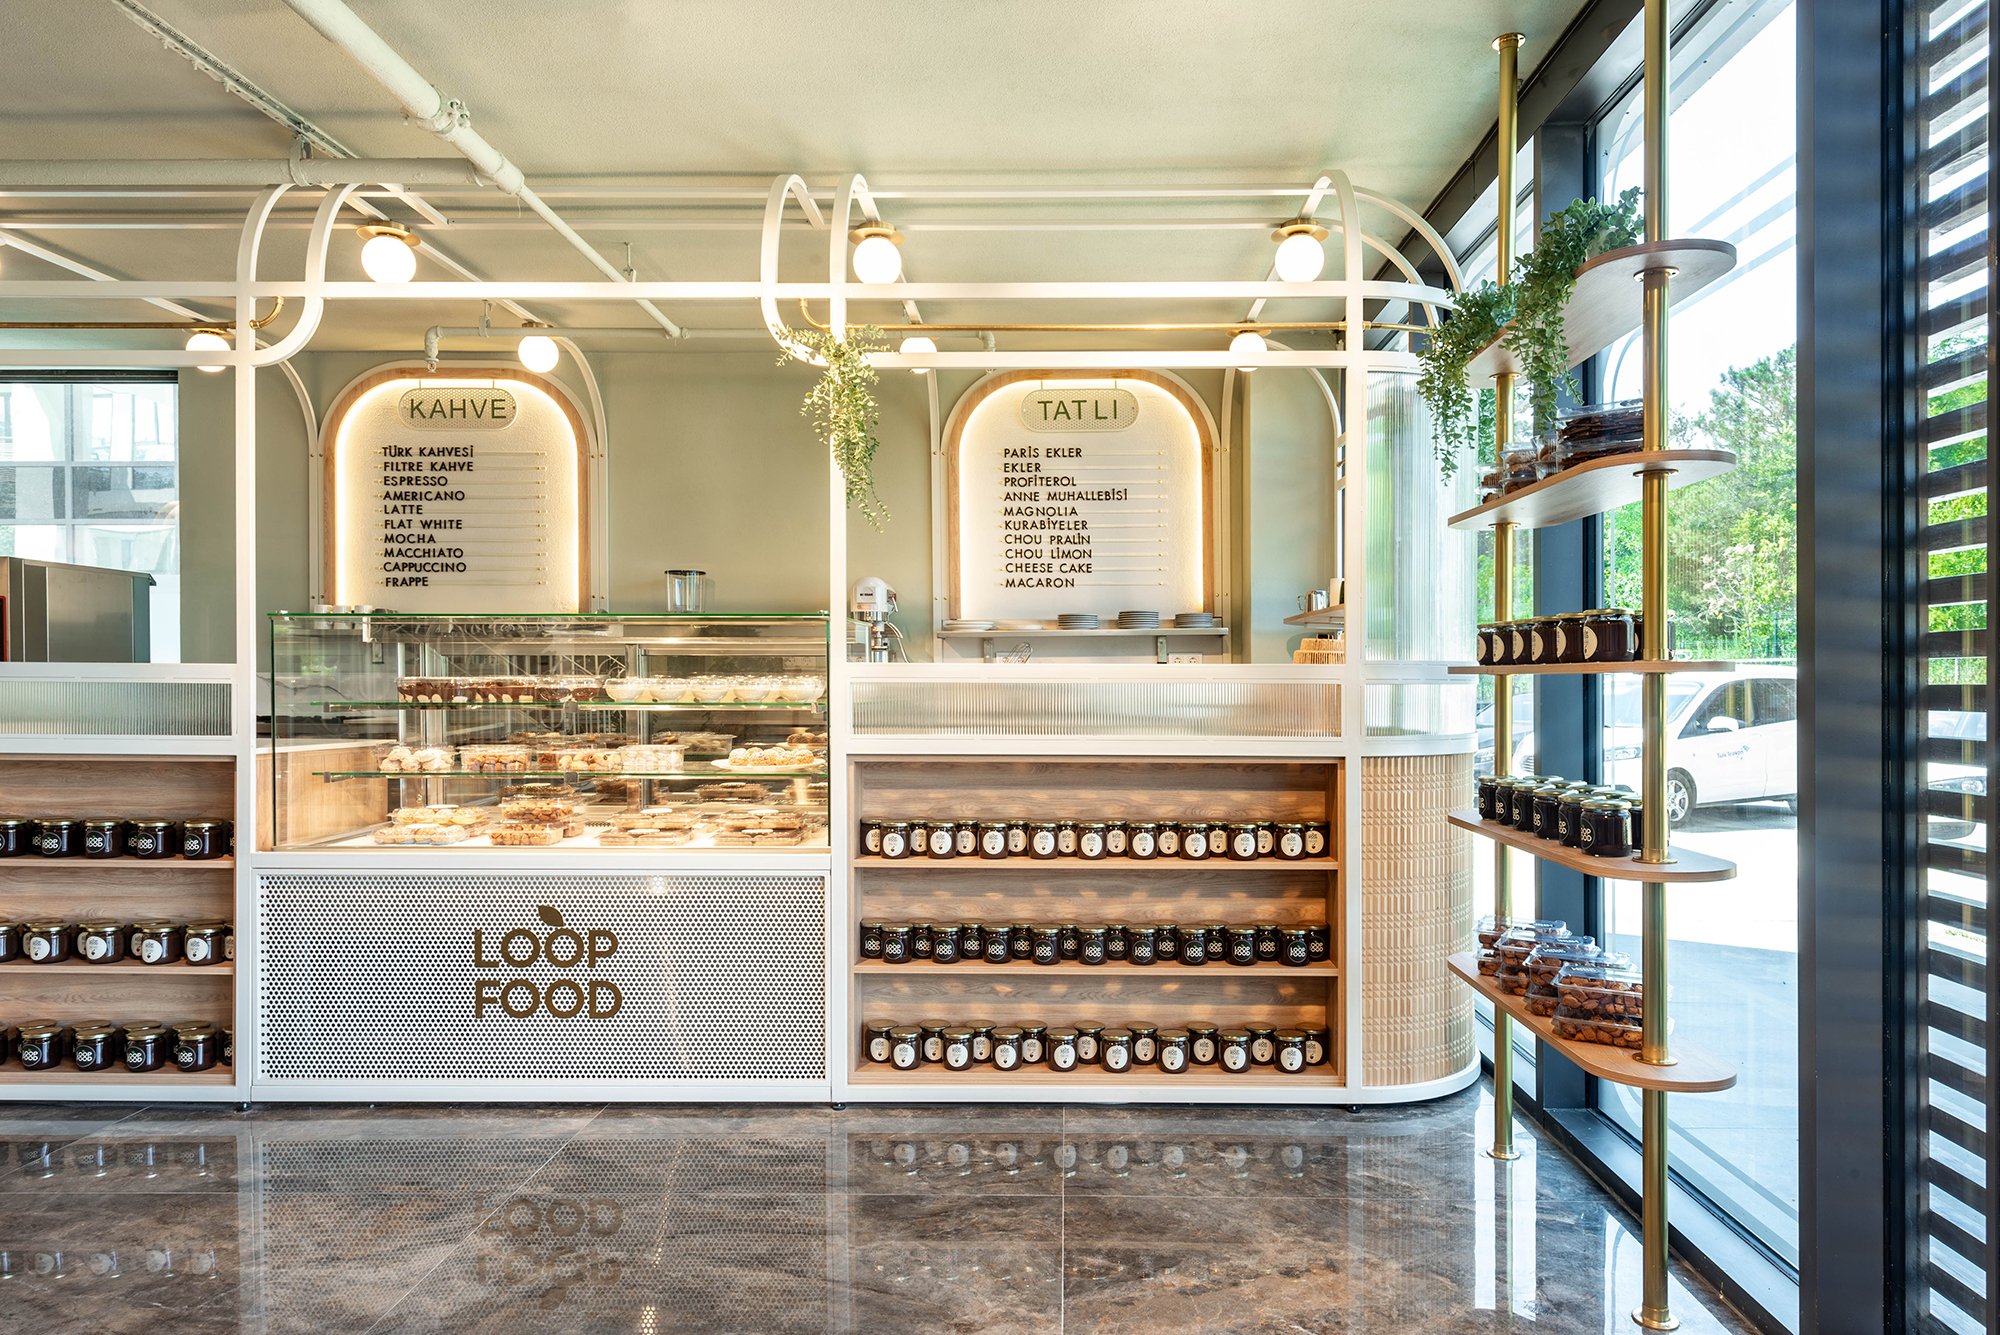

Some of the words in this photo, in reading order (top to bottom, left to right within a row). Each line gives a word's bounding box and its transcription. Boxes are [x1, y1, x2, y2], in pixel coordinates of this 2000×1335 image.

[410, 398, 507, 419] KAHVE
[1038, 399, 1118, 421] TATLI
[382, 445, 412, 457] TÜRK
[419, 445, 474, 457] KAHVESİ
[1004, 446, 1039, 458] PARİS
[1046, 448, 1082, 458] EKLER
[384, 462, 423, 471] FILTRE
[430, 462, 474, 471] KAHVE
[1003, 463, 1042, 473] EKLER
[384, 476, 448, 486] ESPRESSO
[1004, 474, 1077, 487] PROFİTEROL
[383, 491, 465, 501] AMERICANO
[1004, 492, 1040, 502] ANNE
[1047, 488, 1128, 502] MUHALLEBİSİ
[384, 505, 423, 515] LATTE
[1003, 506, 1078, 517] MAGNOLIA
[384, 519, 412, 529] FLAT
[420, 520, 463, 529] WHITE
[1004, 518, 1088, 530] KURABİYELER
[384, 534, 436, 544] MOCHA
[1004, 534, 1042, 544] CHOU
[1049, 533, 1091, 545] PRALİN
[384, 548, 463, 558] MACCHIATO
[1005, 549, 1043, 559] CHOU
[1050, 547, 1092, 559] LİMON
[383, 562, 466, 573] CAPPUCCINO
[1005, 563, 1053, 573] CHEESE
[1059, 563, 1093, 574] CAKE
[385, 577, 428, 587] FRAPPE
[1005, 578, 1075, 588] MACARON
[474, 928, 619, 968] LOOP
[475, 979, 623, 1019] FOOD
